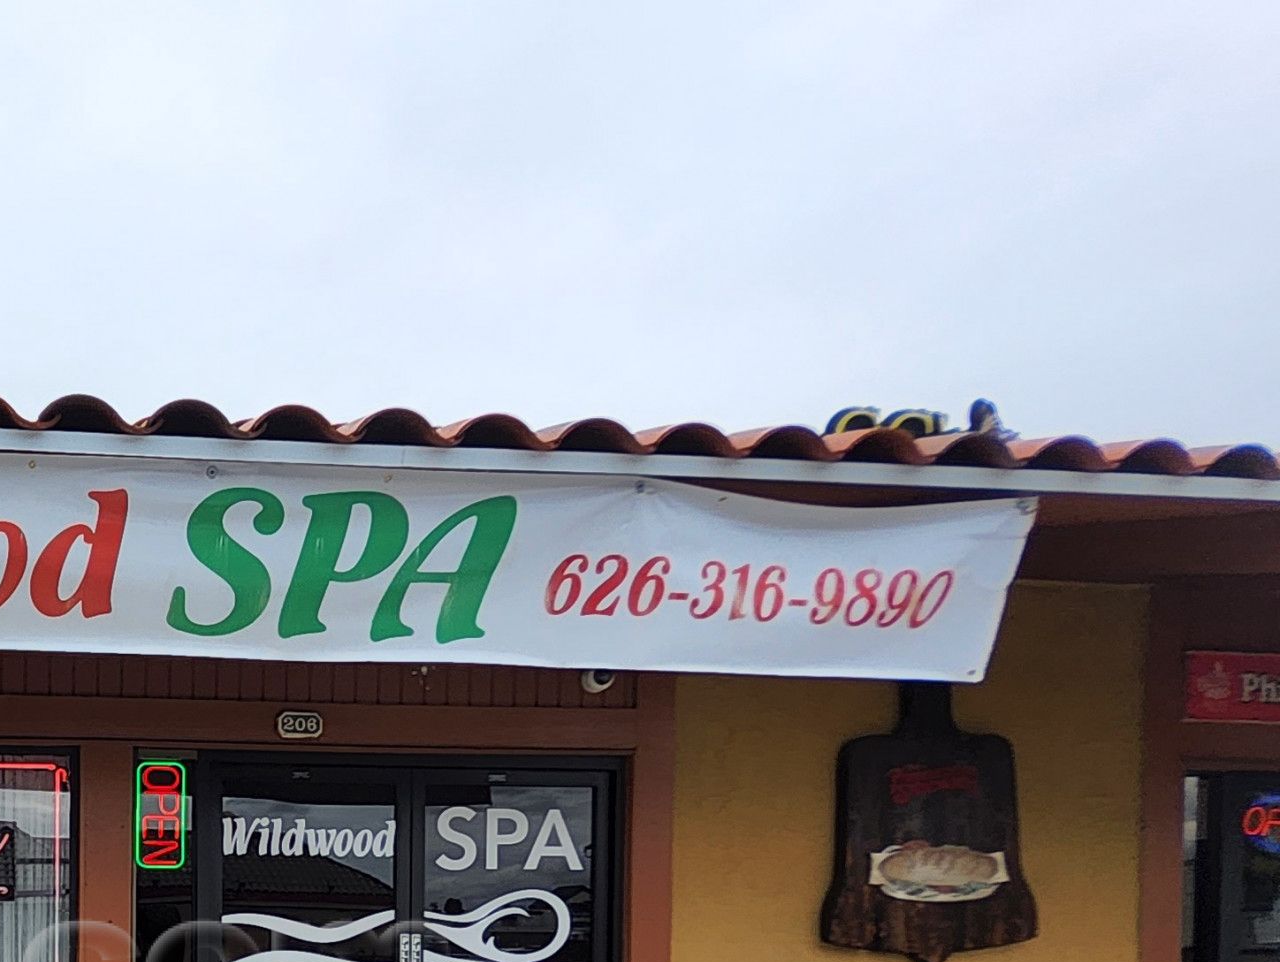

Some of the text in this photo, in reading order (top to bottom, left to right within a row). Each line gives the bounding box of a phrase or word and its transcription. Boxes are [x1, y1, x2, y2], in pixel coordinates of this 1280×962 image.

[166, 486, 518, 644] SPA
[543, 553, 956, 630] 626-316-9890
[282, 717, 317, 732] 206
[142, 765, 181, 866] OPEN
[222, 805, 584, 872] Wildwood SPA
